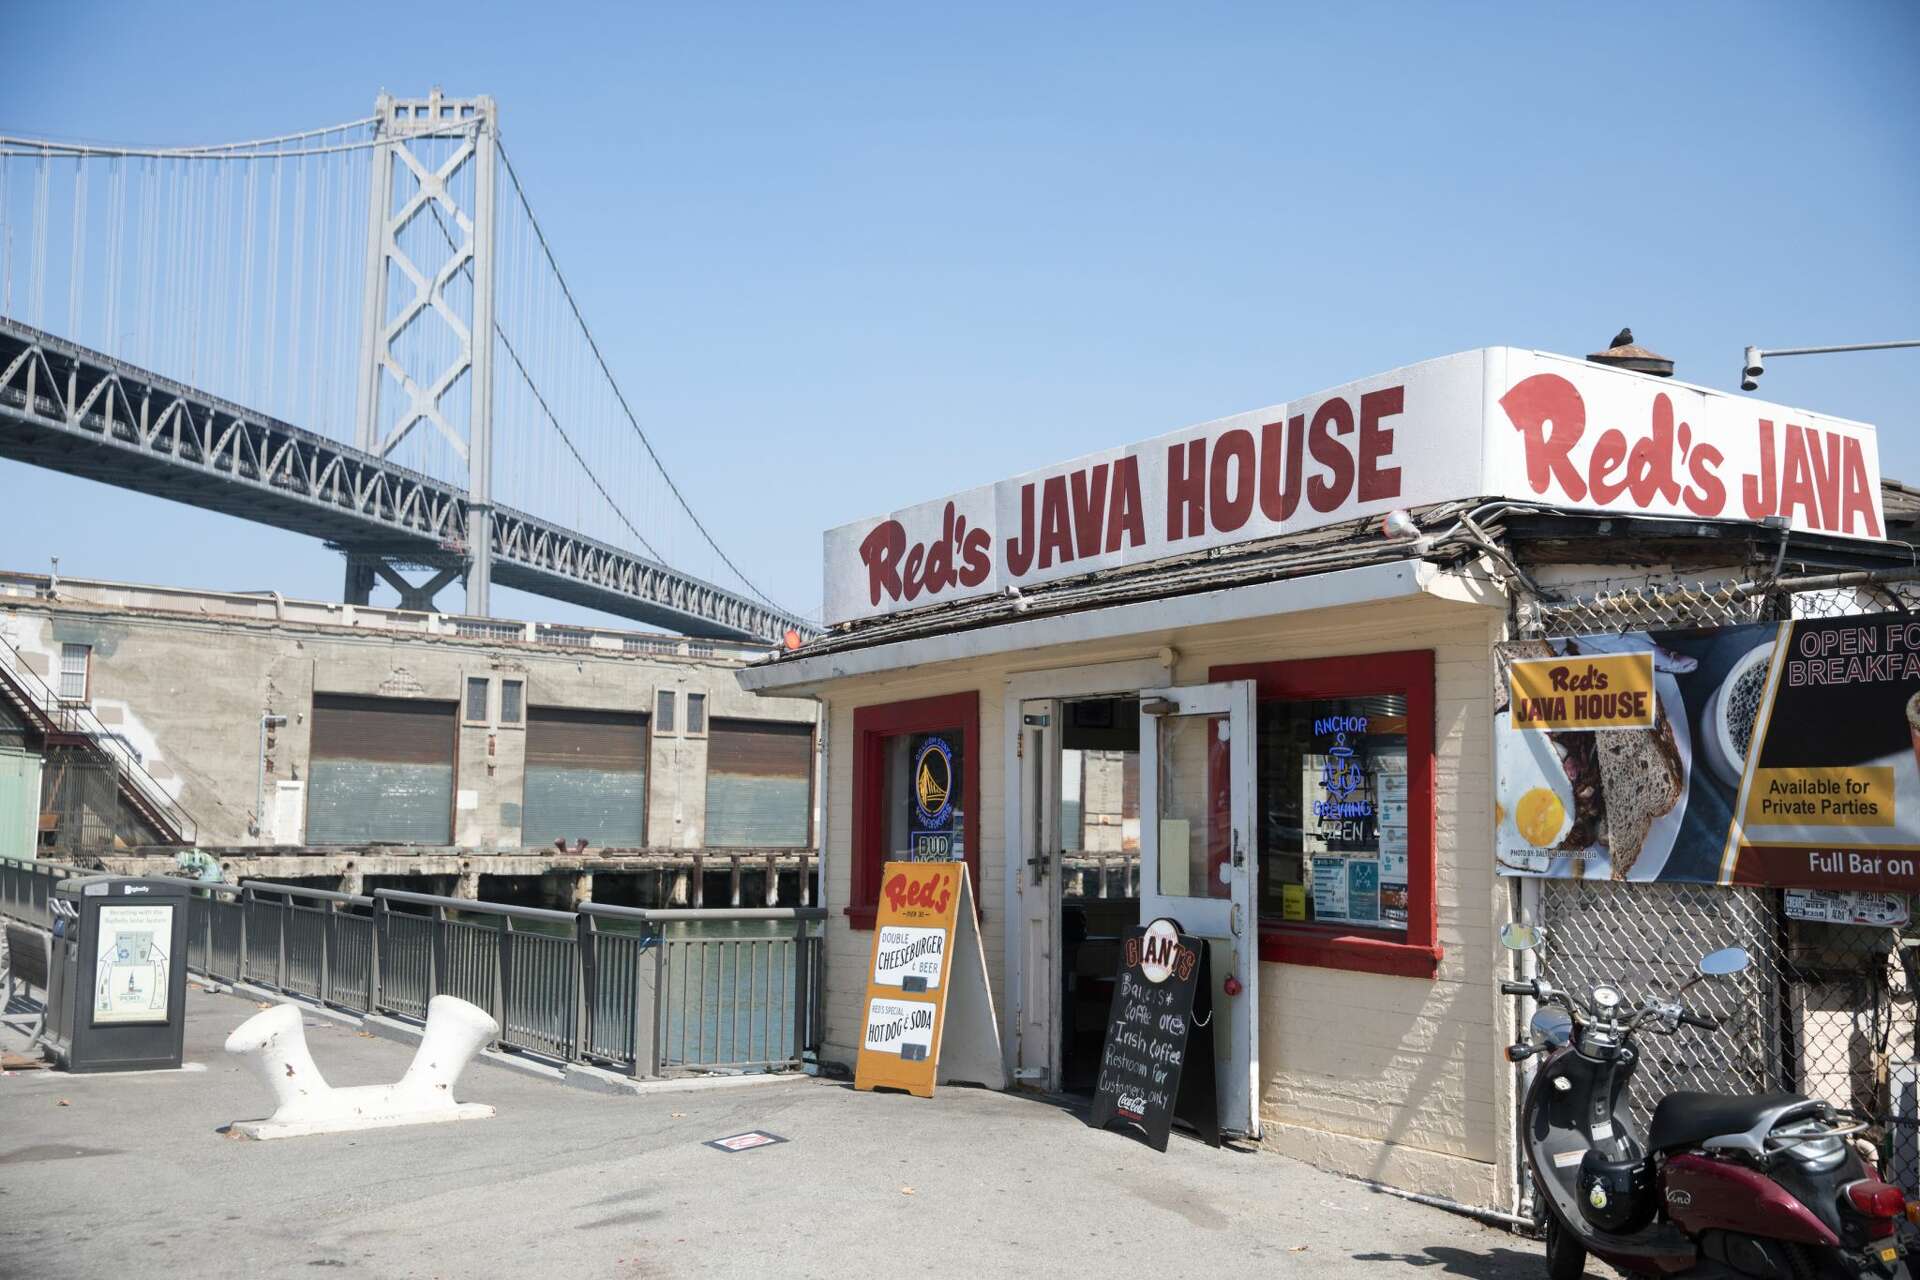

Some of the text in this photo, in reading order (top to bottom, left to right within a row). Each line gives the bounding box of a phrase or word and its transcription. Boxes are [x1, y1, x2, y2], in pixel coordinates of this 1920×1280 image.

[1499, 373, 1882, 538] Red's JAVA
[860, 385, 1405, 606] Red's JAVA HOUSE
[1800, 625, 1877, 658] OPEN
[1548, 664, 1608, 692] Red's
[1517, 691, 1648, 722] JAVA HOUSE
[1315, 716, 1367, 736] ANCHOR
[1769, 778, 1870, 794] Available for
[1313, 800, 1371, 820] BREWING
[1762, 799, 1878, 815] Private Parties
[1320, 820, 1364, 841] OPEN
[918, 835, 949, 856] BUD
[1510, 848, 1526, 857] PHOTO
[1809, 852, 1914, 875] Full Bar on
[885, 873, 951, 913] Red's
[878, 935, 943, 970] CHEESEBURGER
[882, 932, 909, 945] DOUBLE
[919, 961, 938, 974] BEER
[1125, 935, 1196, 981] GIANTS
[868, 1023, 885, 1043] HOT
[885, 1018, 902, 1042] DOG
[910, 1010, 932, 1031] SODA
[1115, 1020, 1146, 1054] Irish
[1105, 1043, 1168, 1084] Restroom for
[1100, 1070, 1145, 1098] Customers
